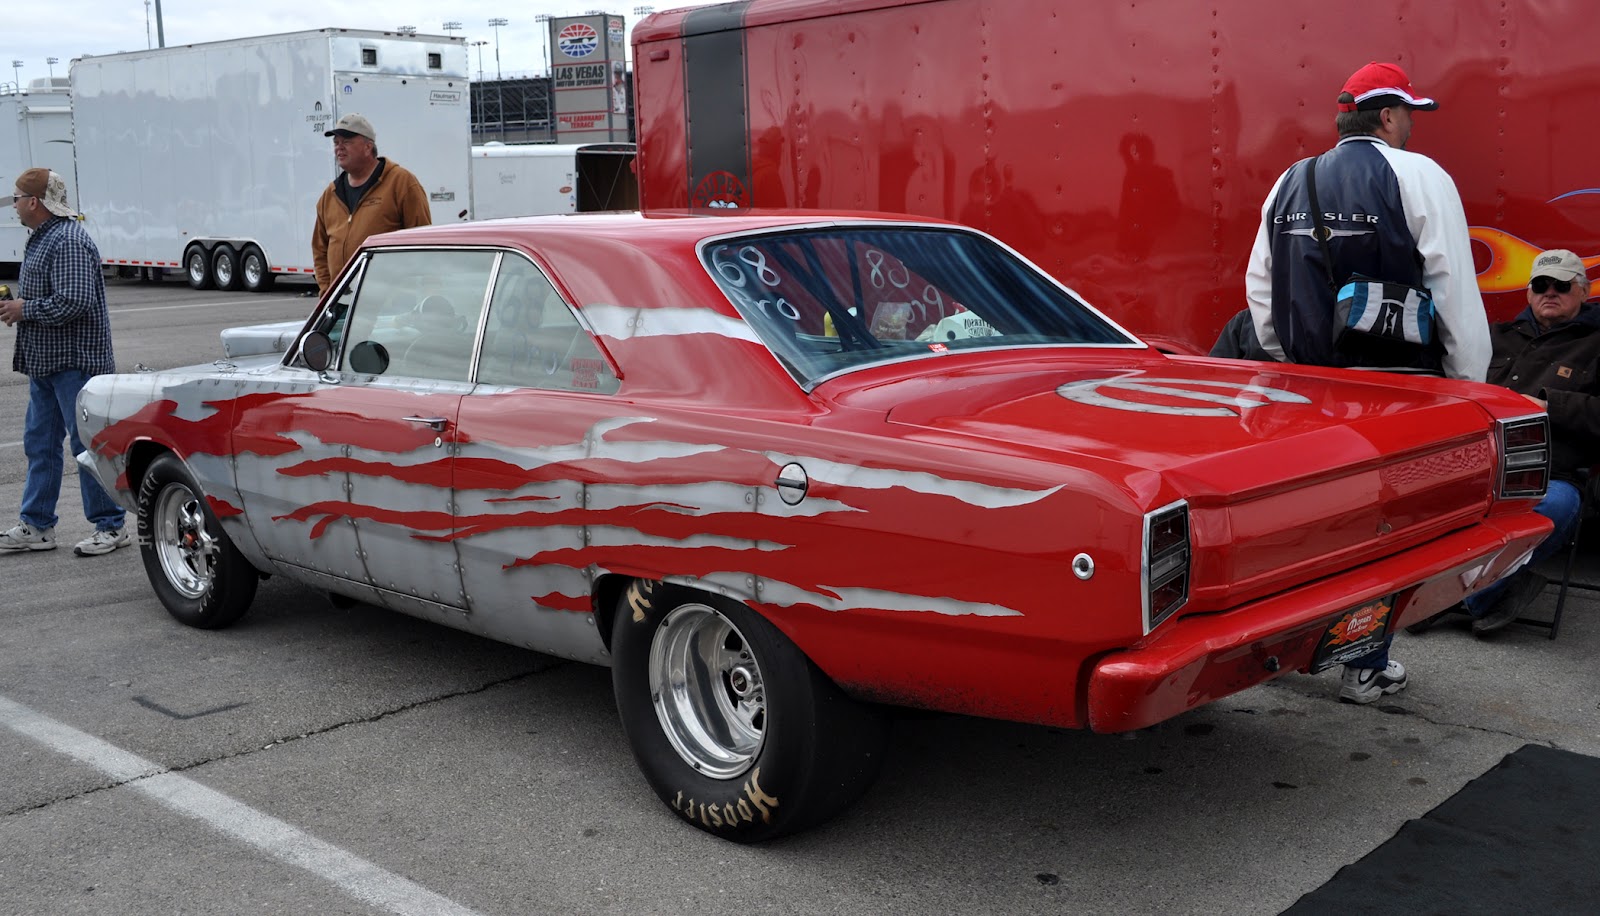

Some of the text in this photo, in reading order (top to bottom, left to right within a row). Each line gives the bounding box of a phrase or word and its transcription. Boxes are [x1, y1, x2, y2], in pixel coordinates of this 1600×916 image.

[556, 65, 604, 80] LAS VEGAS
[576, 79, 605, 87] SPEEDWAY
[570, 121, 594, 129] TERRACE
[697, 174, 743, 207] SUPER
[1274, 212, 1379, 224] CHRSLER
[712, 245, 781, 287] 68
